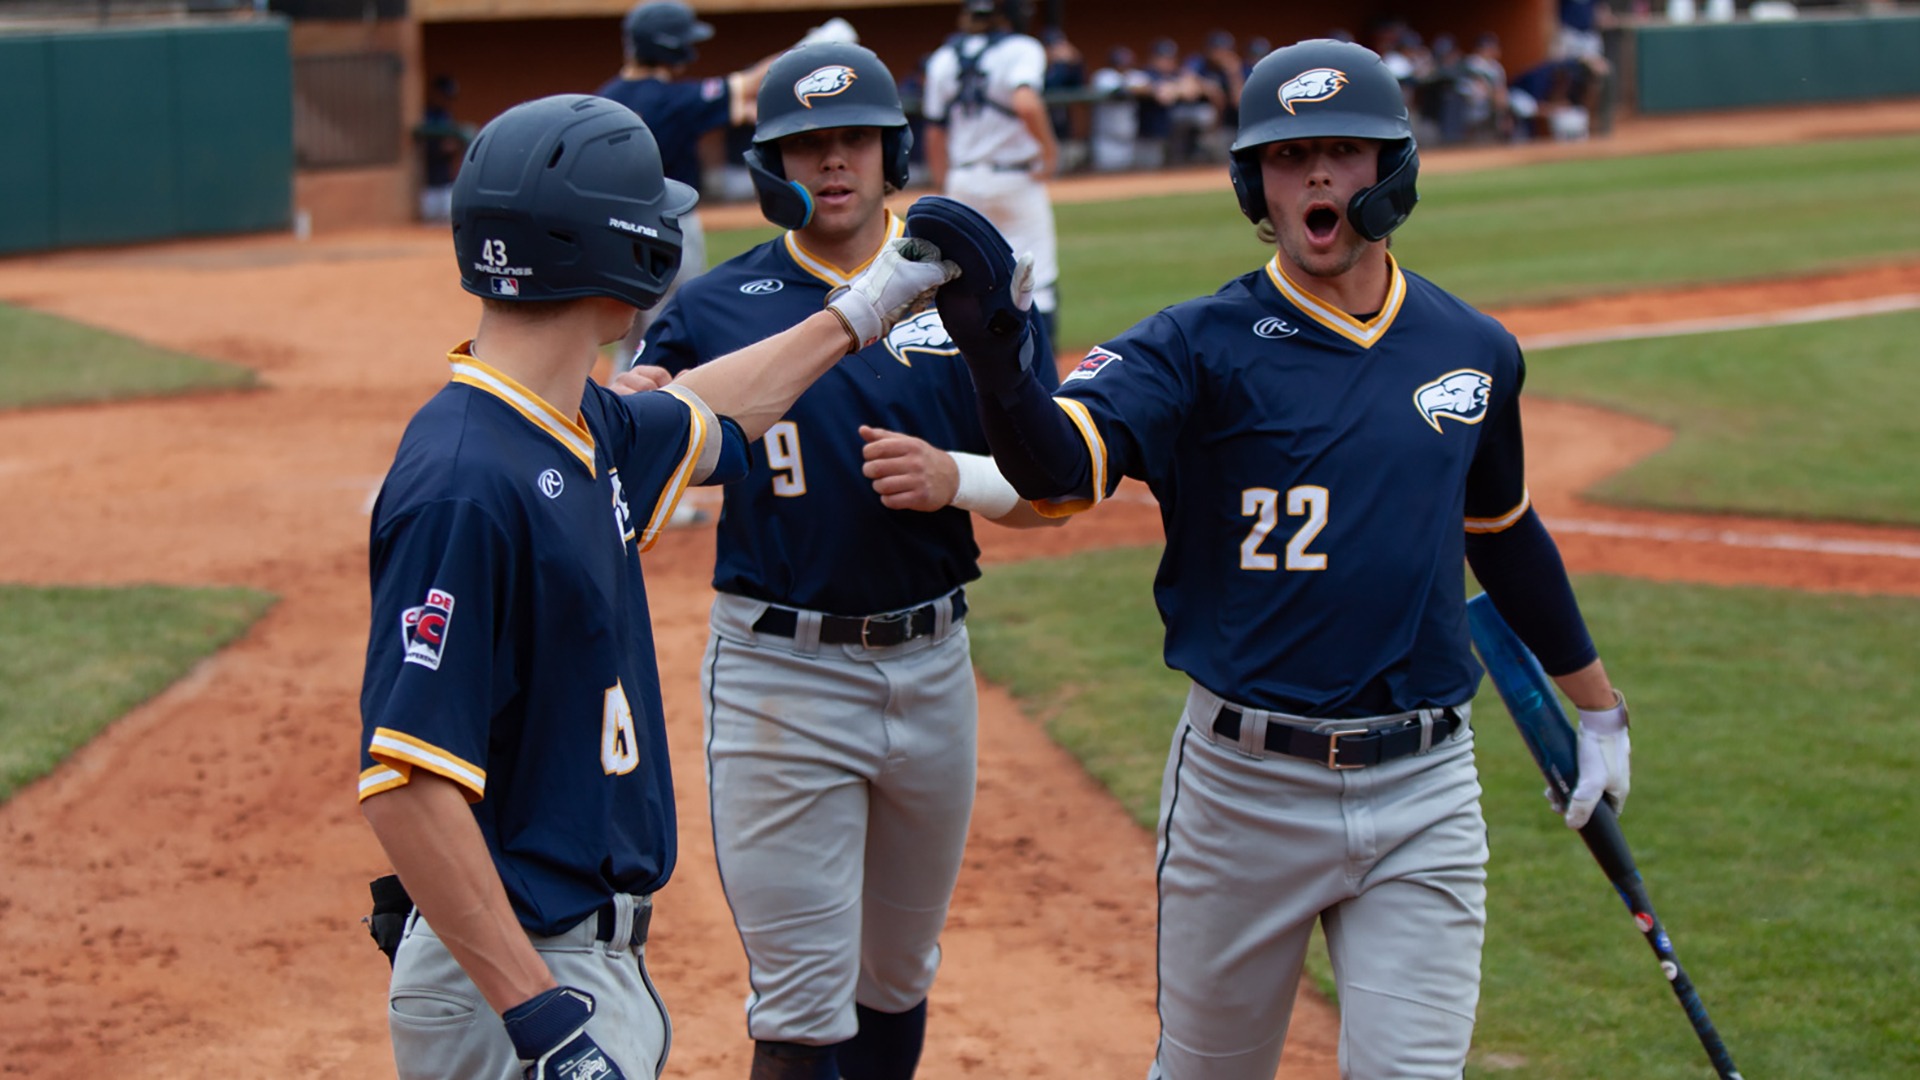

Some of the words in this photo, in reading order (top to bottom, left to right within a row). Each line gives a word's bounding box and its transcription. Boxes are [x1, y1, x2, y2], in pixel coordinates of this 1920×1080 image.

[482, 238, 508, 267] 43
[763, 420, 807, 497] 9
[1240, 484, 1329, 571] 22
